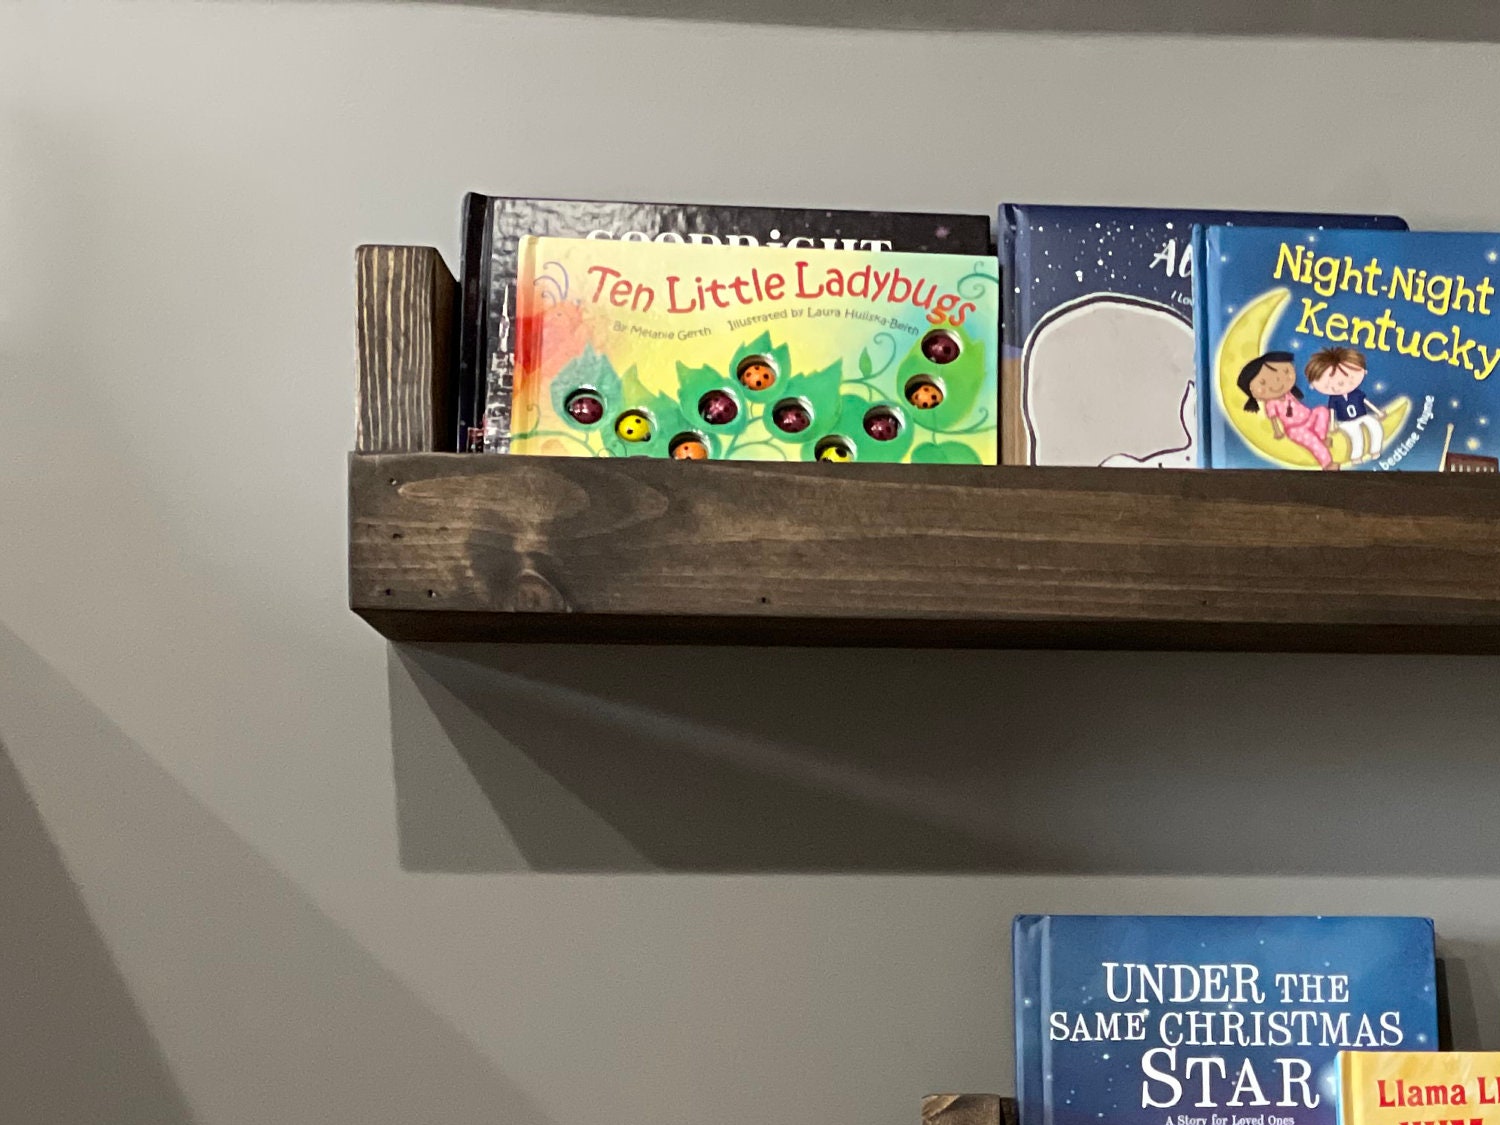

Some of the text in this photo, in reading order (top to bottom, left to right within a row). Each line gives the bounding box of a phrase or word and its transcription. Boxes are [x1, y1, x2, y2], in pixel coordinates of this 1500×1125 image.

[587, 261, 976, 327] Ten Little Ladybugs
[1273, 242, 1495, 316] Night-Night
[630, 325, 675, 340] Melanie
[677, 327, 712, 341] Gerth
[727, 309, 788, 332] Illustrated
[791, 307, 804, 318] by
[807, 307, 841, 318] Laura
[1379, 431, 1420, 471] bedtime
[1101, 962, 1350, 1004] UNDER THE
[1049, 1010, 1404, 1048] SAME CHRISTMAS
[1140, 1047, 1320, 1109] STAR
[1377, 1078, 1467, 1107] Llama
[1211, 1113, 1228, 1125] for
[1232, 1113, 1265, 1125] Loved
[1268, 1115, 1295, 1125] Ones
